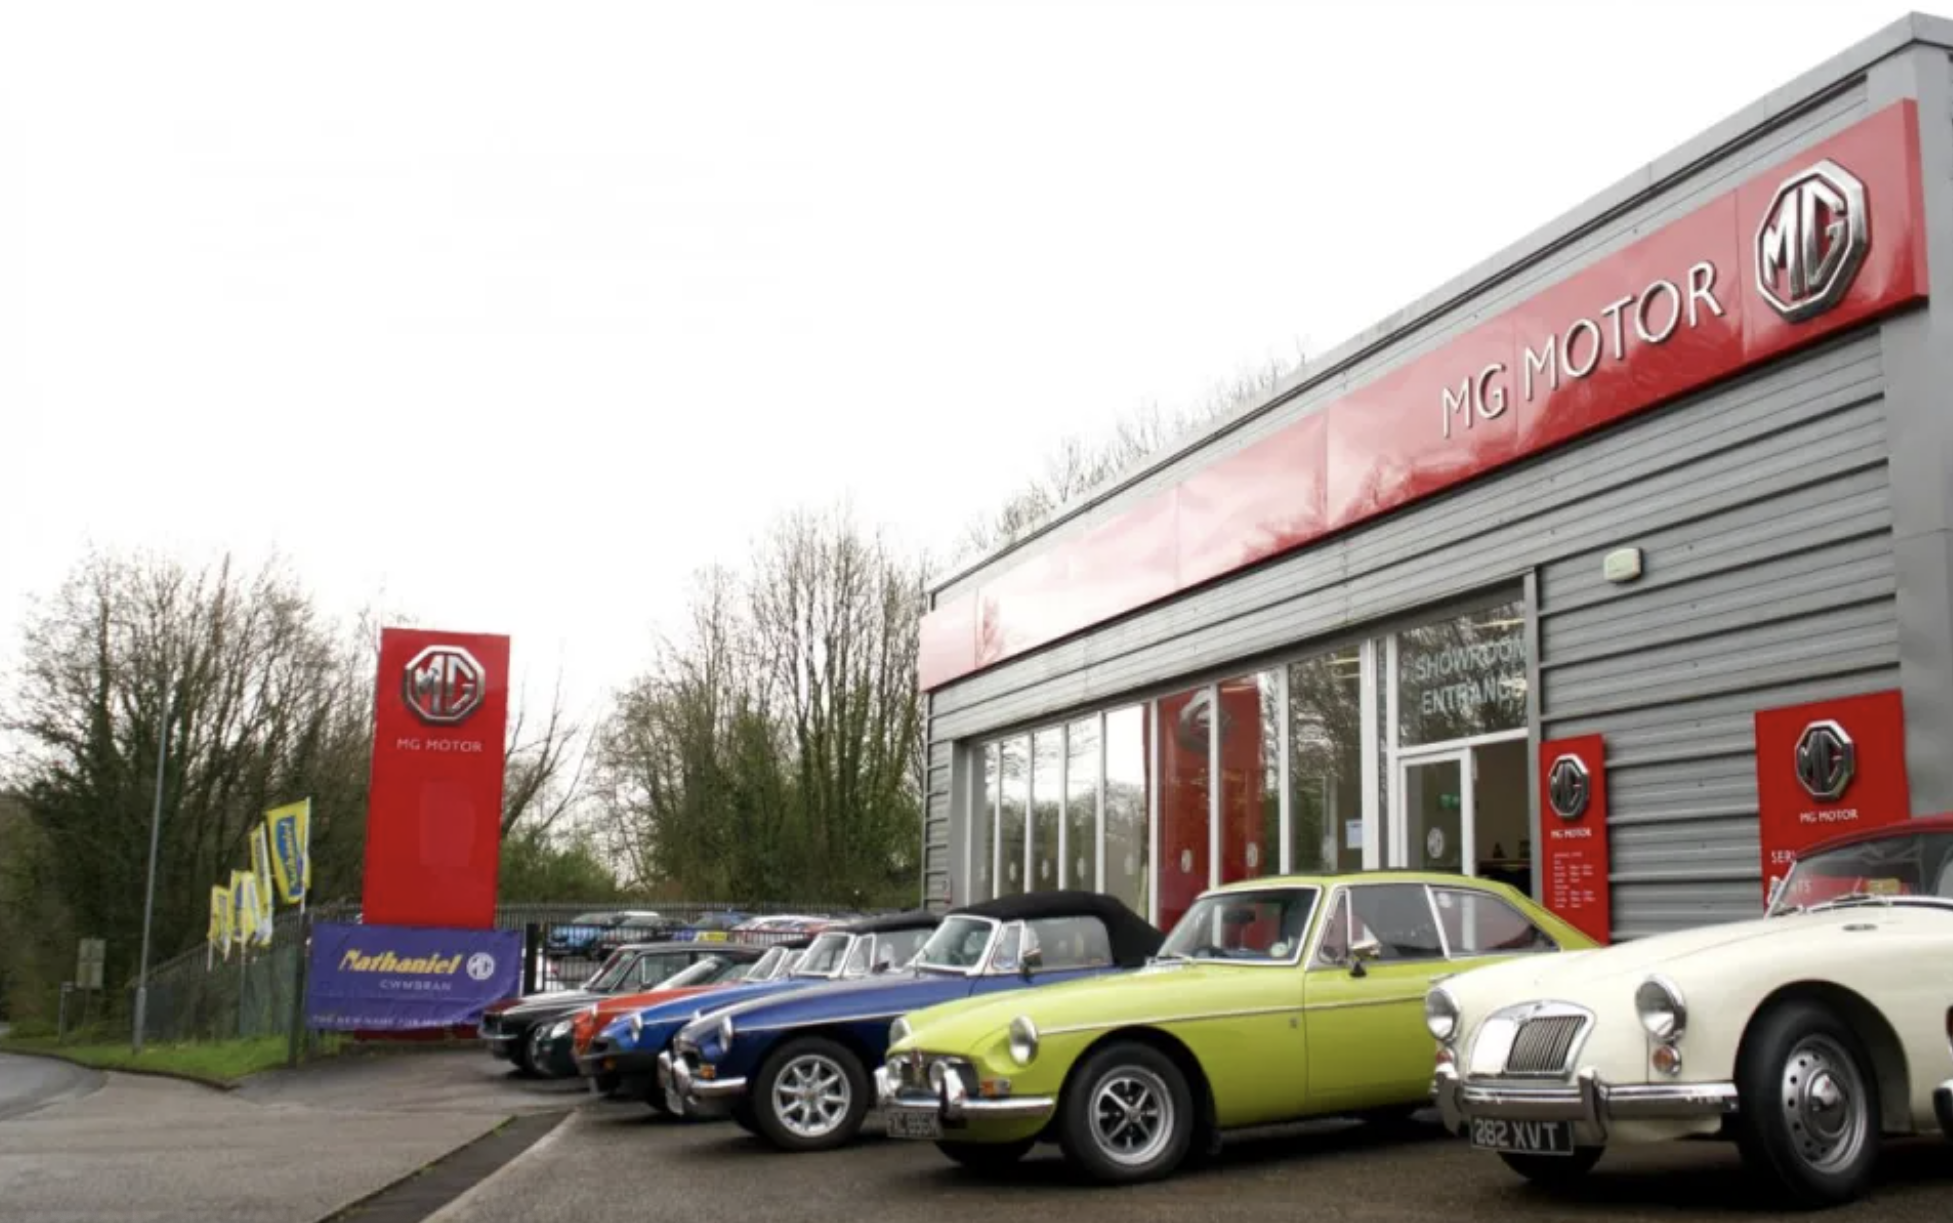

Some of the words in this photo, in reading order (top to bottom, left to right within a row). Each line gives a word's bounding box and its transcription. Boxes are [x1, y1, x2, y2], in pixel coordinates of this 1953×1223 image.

[1760, 170, 1855, 308] MG
[1441, 362, 1508, 438] MG
[1522, 260, 1724, 402] MOTOR
[411, 650, 479, 717] MG
[396, 738, 420, 750] MG
[425, 740, 482, 752] MOTOR
[1798, 726, 1848, 794] MG
[1551, 758, 1584, 814] MG
[1800, 811, 1817, 823] MG
[1818, 809, 1859, 822] MOTOR
[338, 949, 464, 975] Nathaniel
[379, 979, 451, 991] CWMBRAN
[1474, 1119, 1508, 1146] 282
[1511, 1120, 1558, 1151] XVT
